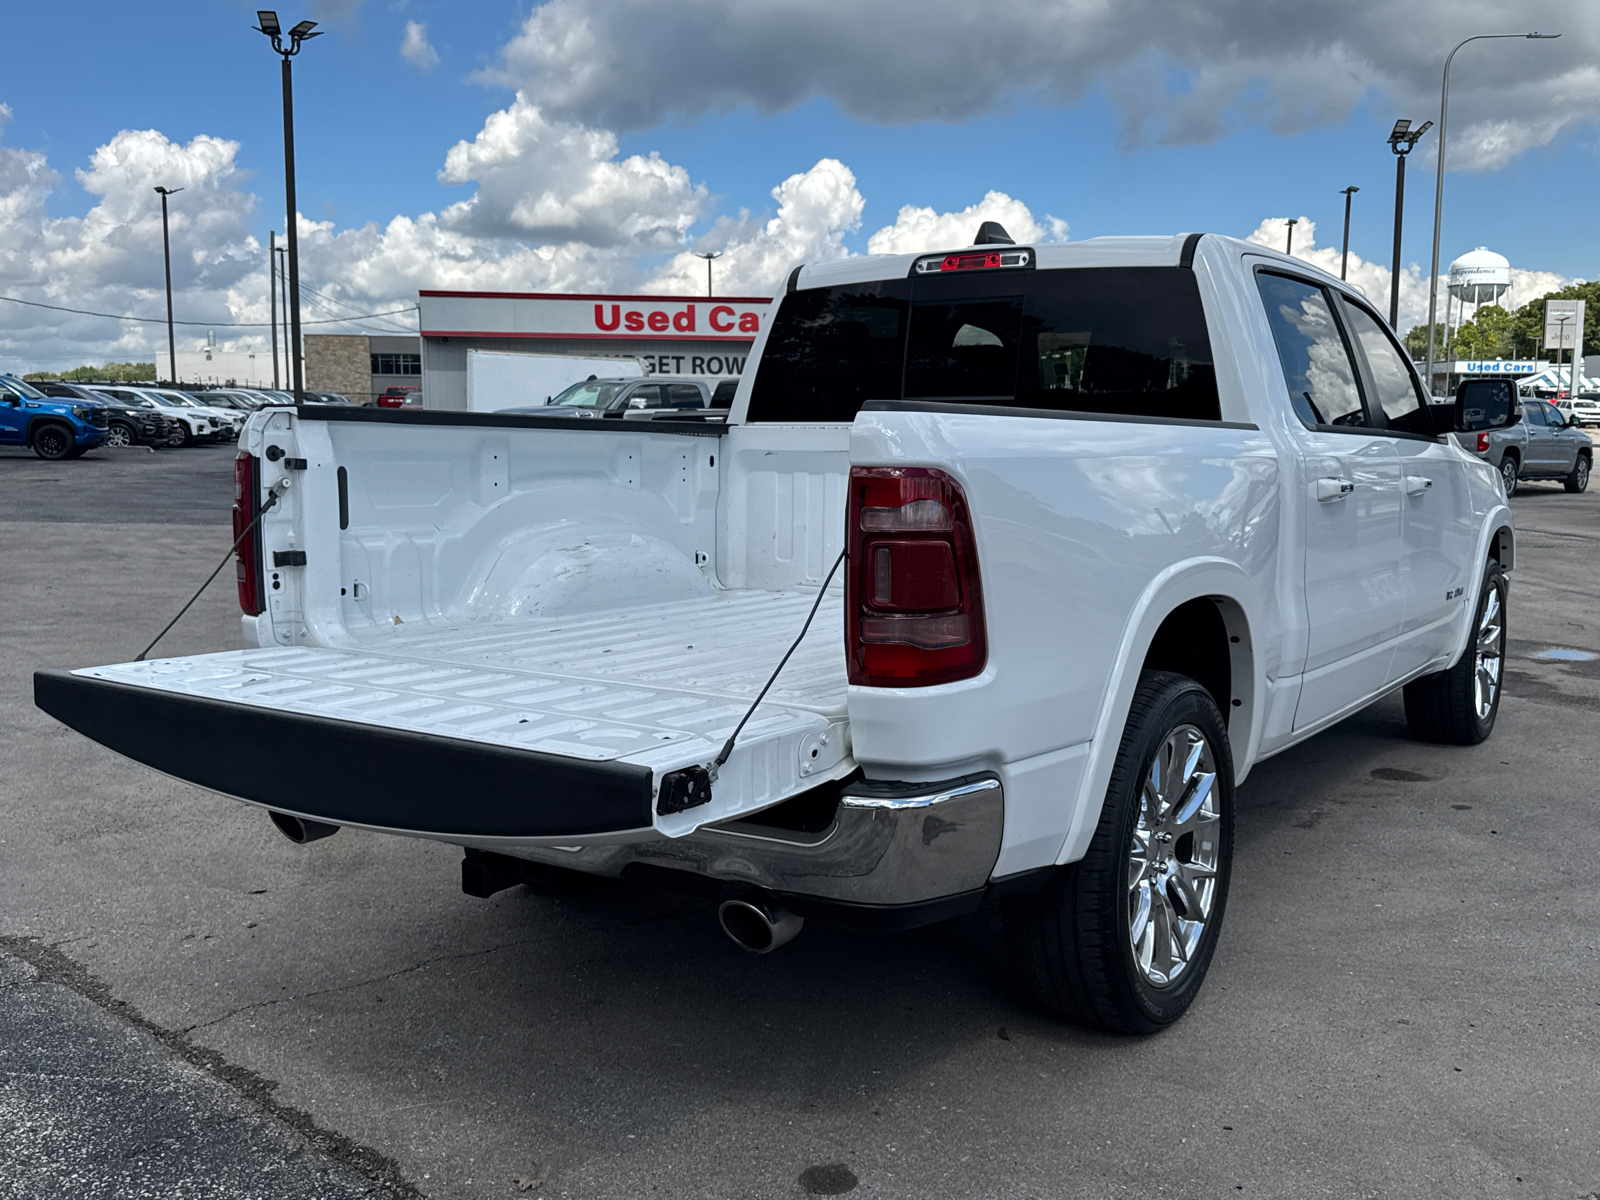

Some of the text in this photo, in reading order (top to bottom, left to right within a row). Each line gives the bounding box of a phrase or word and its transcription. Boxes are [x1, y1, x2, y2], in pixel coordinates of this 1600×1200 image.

[594, 304, 766, 332] Used Ca
[1551, 333, 1570, 341] Jeep
[1467, 362, 1534, 372] Used Cars
